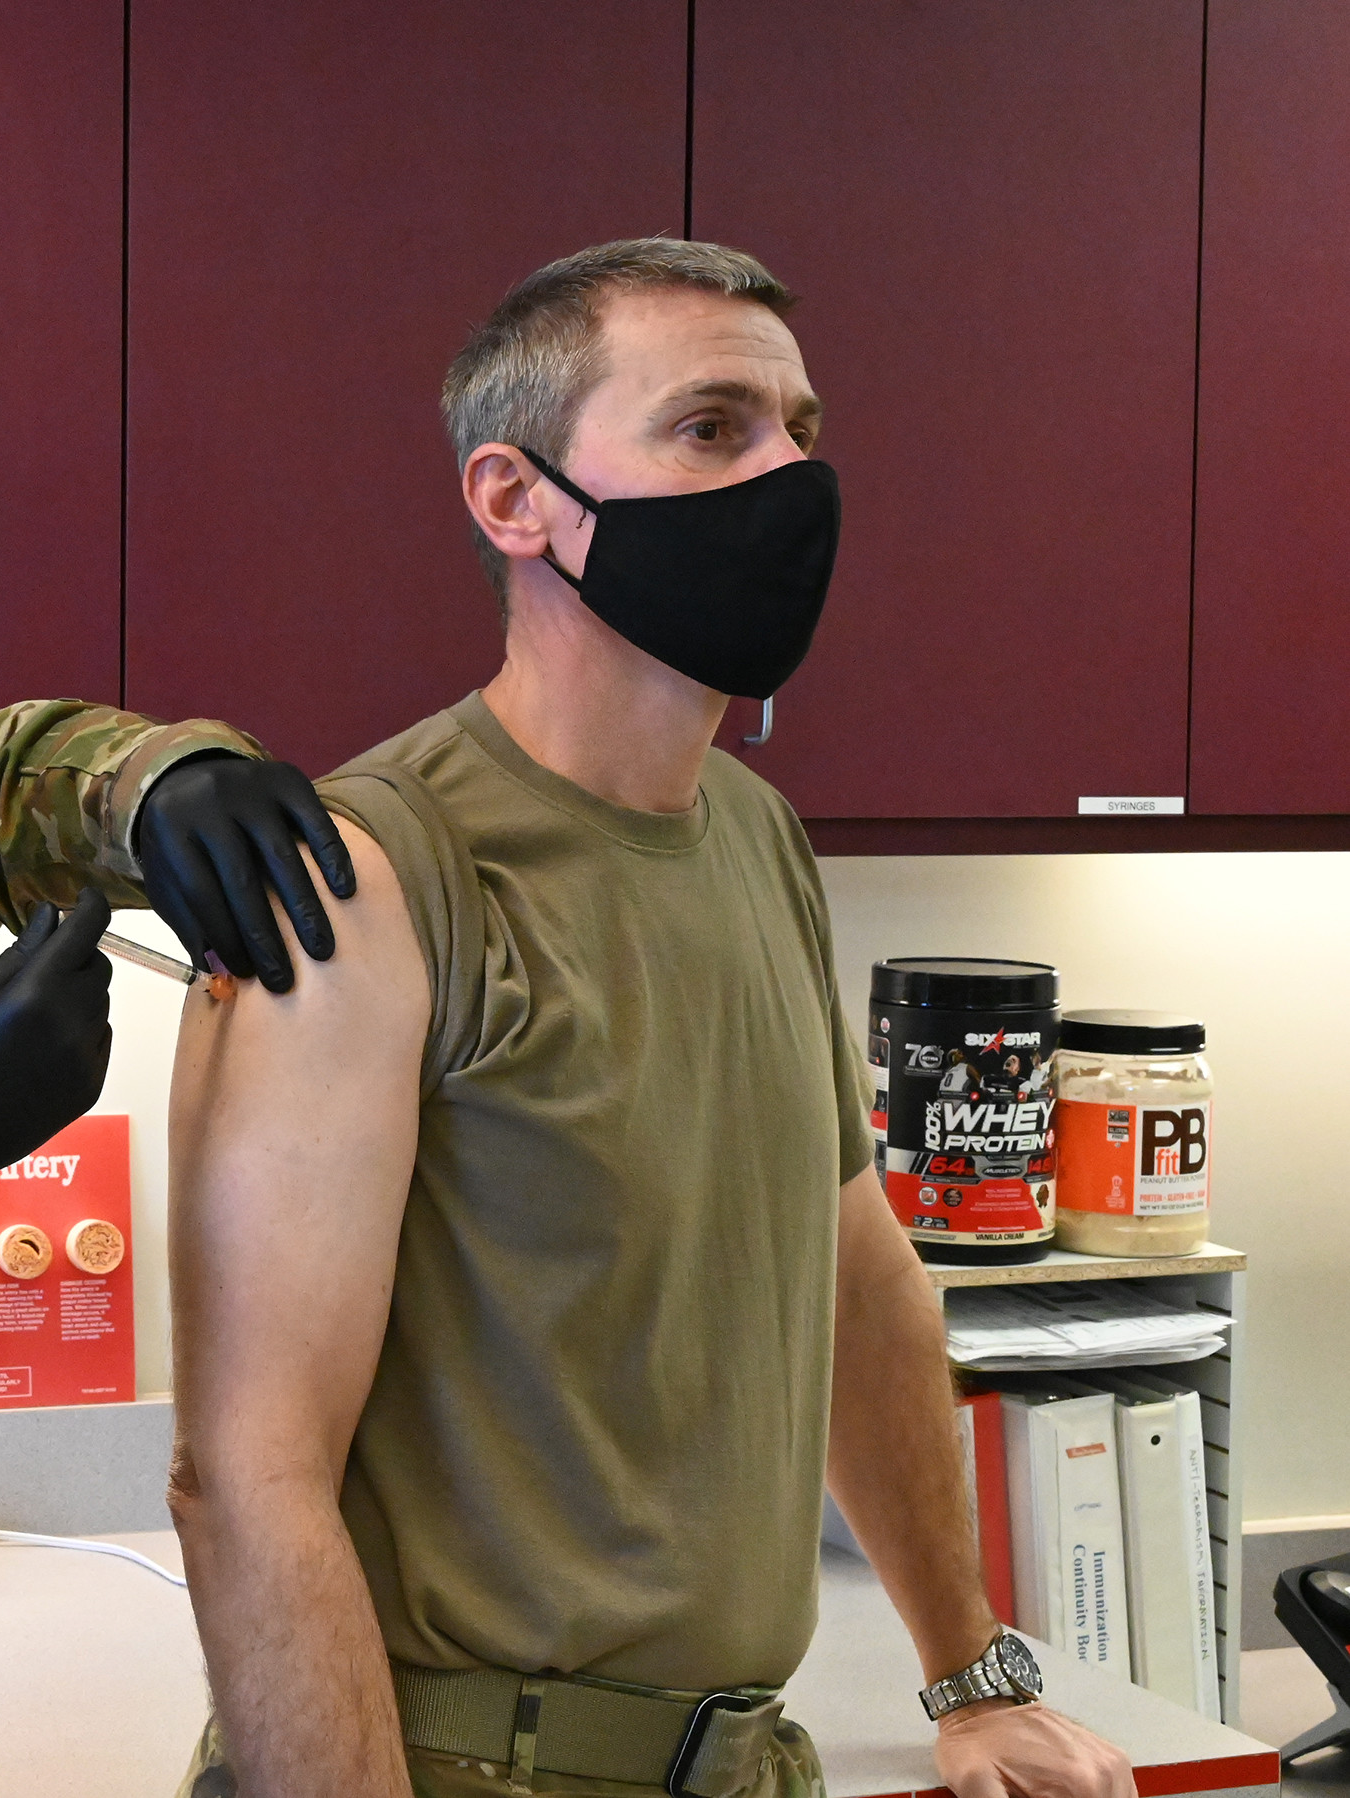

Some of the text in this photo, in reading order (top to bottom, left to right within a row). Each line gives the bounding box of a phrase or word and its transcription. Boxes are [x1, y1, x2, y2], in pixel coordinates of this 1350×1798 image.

[1108, 802, 1155, 811] SYRINGES
[965, 1032, 1040, 1046] SIX STAR
[924, 1101, 941, 1151] 100%
[945, 1099, 1056, 1133] WHEY
[945, 1133, 1046, 1151] PROTEIN
[1141, 1108, 1206, 1175] PB
[1156, 1149, 1180, 1175] fit
[1004, 1232, 1024, 1240] CREAM
[1072, 1544, 1087, 1630] Continuity
[1093, 1551, 1108, 1662] Immunization
